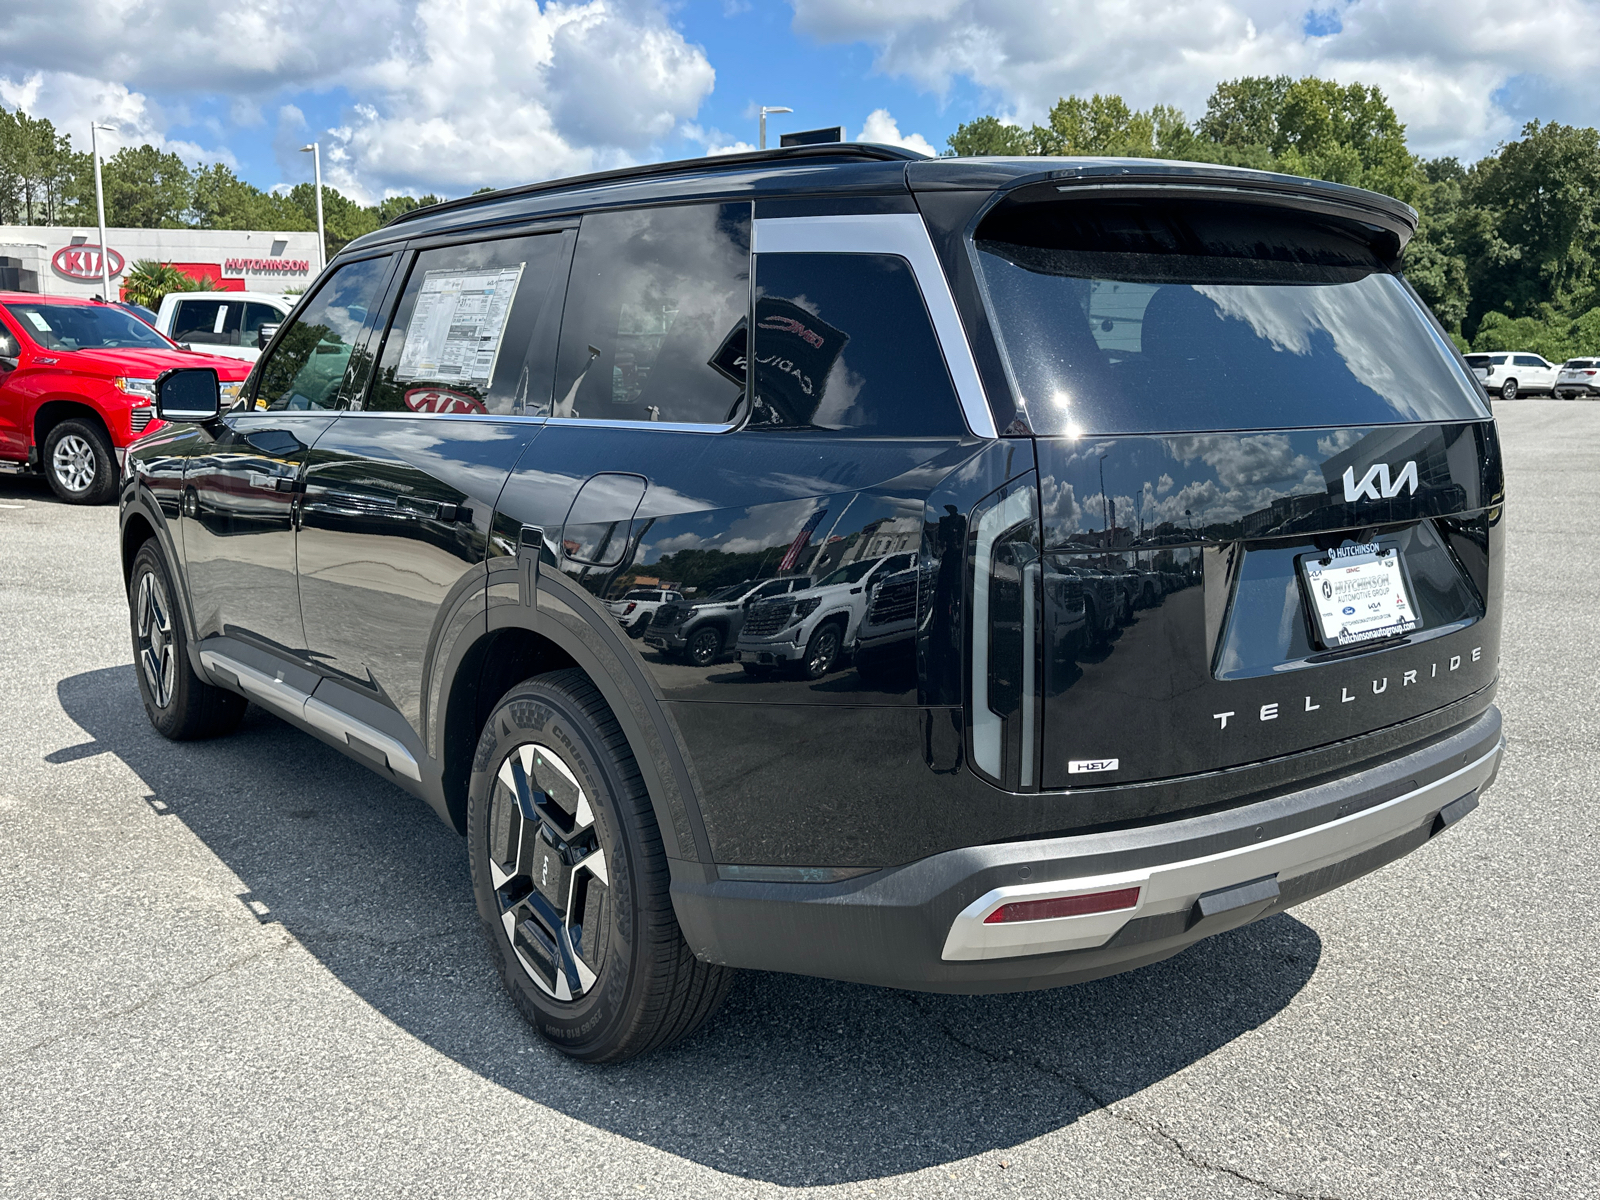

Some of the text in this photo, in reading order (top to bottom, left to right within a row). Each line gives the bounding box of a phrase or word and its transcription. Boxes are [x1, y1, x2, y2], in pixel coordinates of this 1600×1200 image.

[64, 252, 114, 277] KIA
[225, 258, 309, 272] HUTCHINSON
[1343, 461, 1419, 502] KIA
[1336, 543, 1380, 557] HUTCHINSON
[1334, 574, 1390, 595] HUTCHINSON
[1338, 587, 1390, 603] AUTOMOTIVE GROUP
[1339, 622, 1416, 645] Hutchinsonautogroup.com
[1213, 647, 1482, 730] TELLURIDE
[552, 725, 604, 807] CRUGEN
[1077, 761, 1113, 771] HEV
[468, 796, 480, 889] KUMHO
[545, 1007, 603, 1039] 235/65 R18 106H
